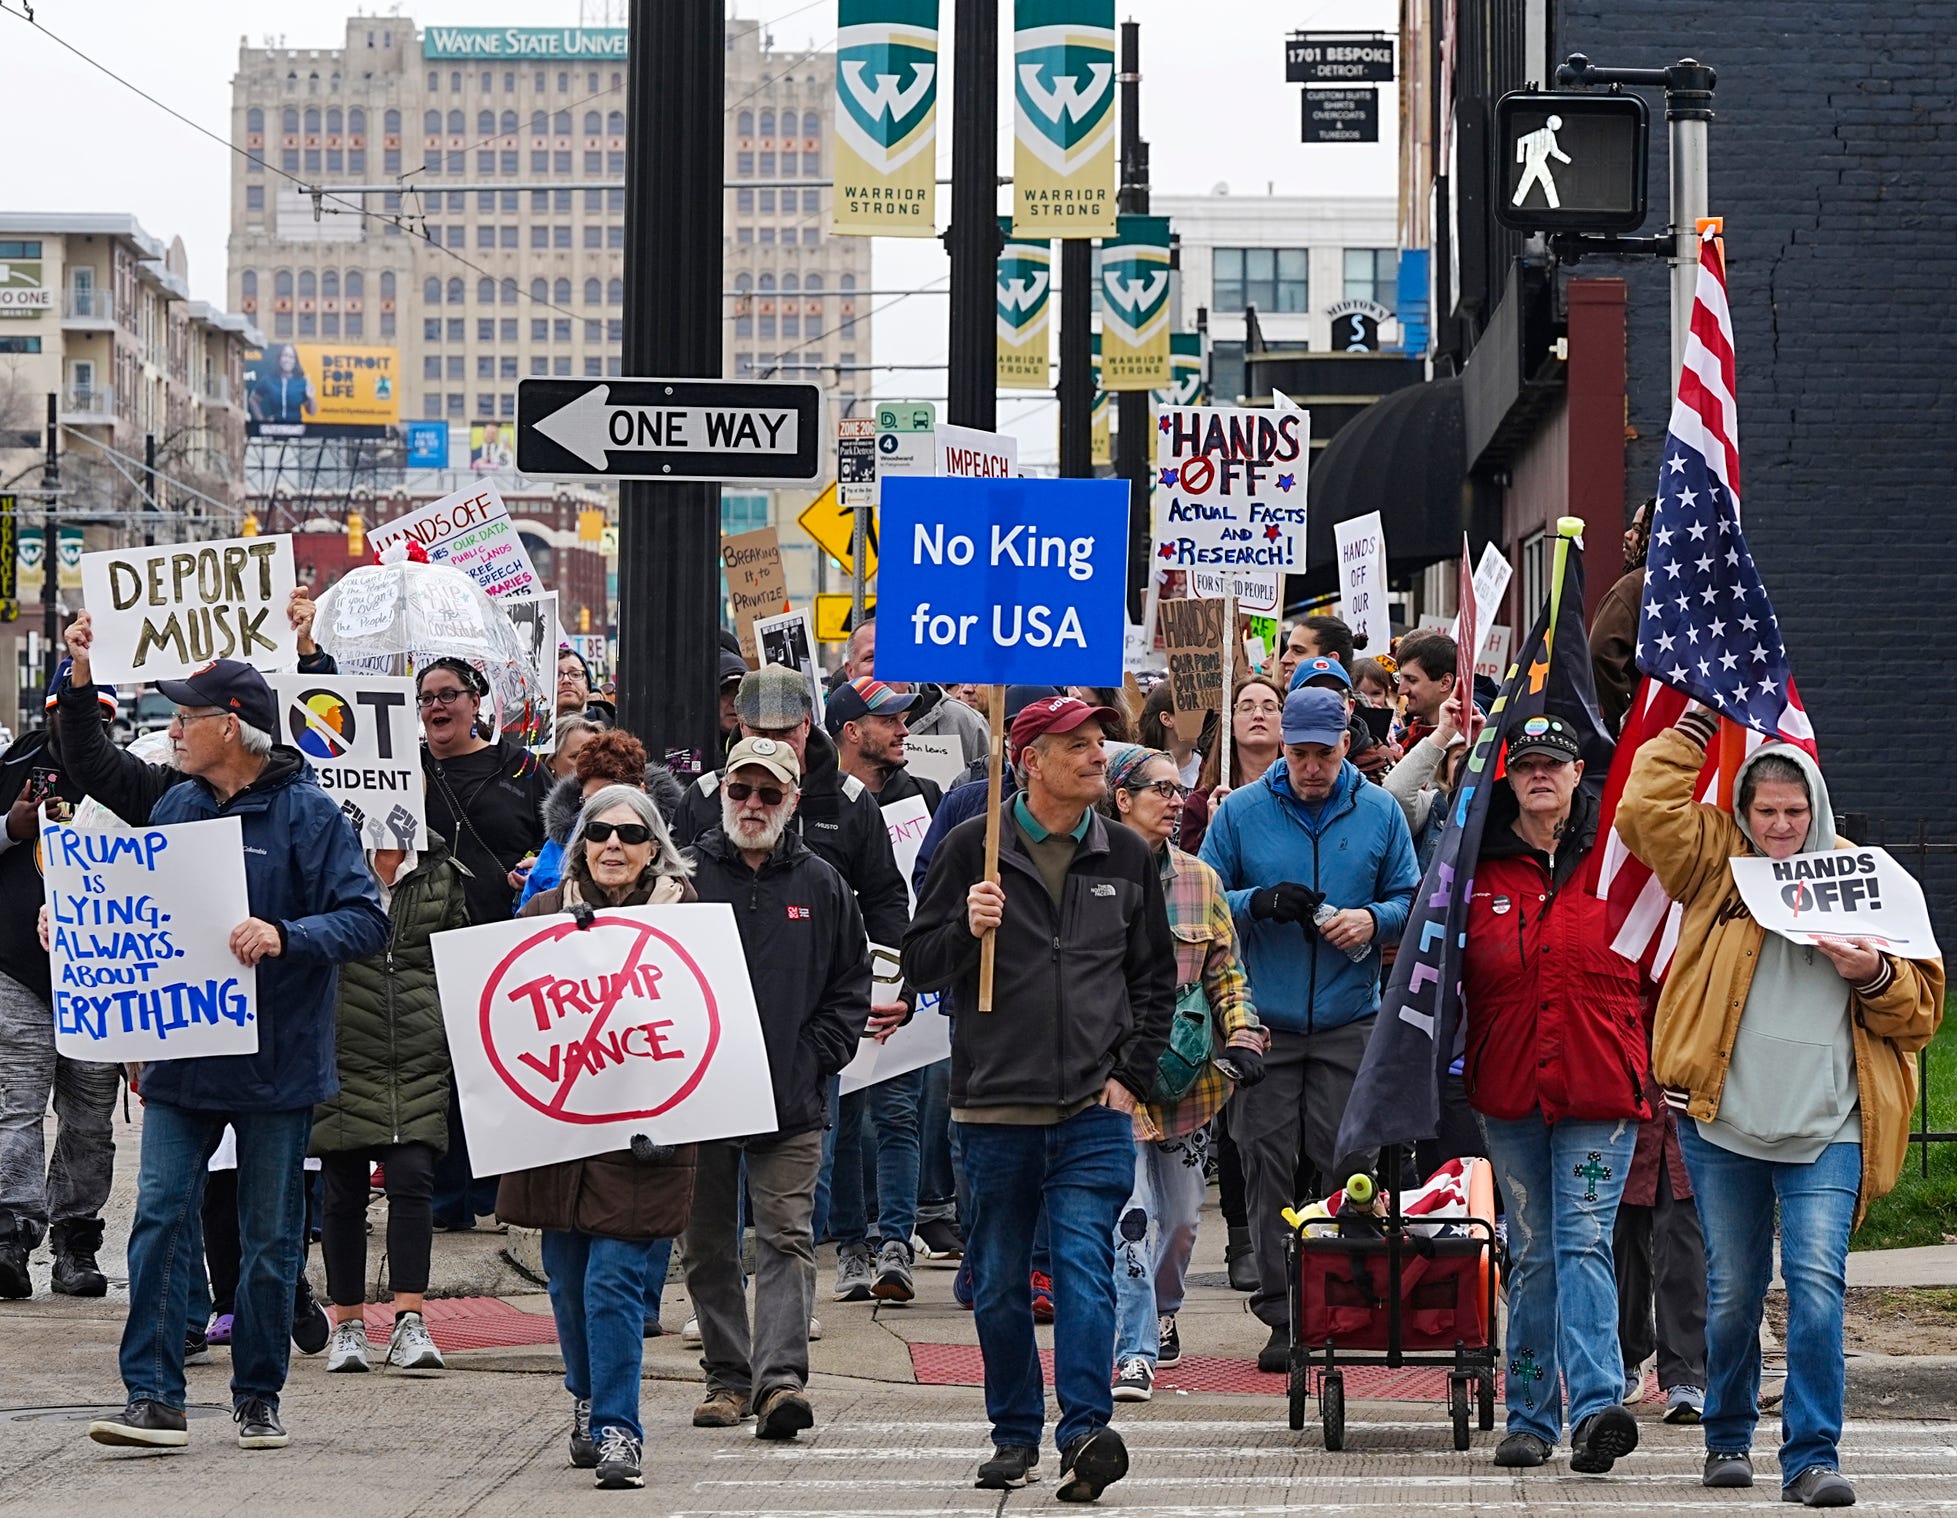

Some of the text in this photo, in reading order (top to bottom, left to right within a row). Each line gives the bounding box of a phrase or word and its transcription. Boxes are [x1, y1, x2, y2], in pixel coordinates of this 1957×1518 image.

[432, 29, 499, 53] WAYNE
[505, 29, 560, 53] STATE
[1288, 47, 1391, 63] 1701 BESPOKE
[1317, 64, 1364, 76] DETROIT
[845, 186, 926, 200] WARRIOR
[1024, 188, 1106, 201] WARRIOR
[850, 201, 920, 215] STRONG
[1030, 203, 1100, 216] STRONG
[17, 291, 49, 304] ONE
[1327, 300, 1386, 318] MIDTOWN
[322, 355, 391, 370] DETROIT
[998, 356, 1043, 364] ARRIOR
[1000, 366, 1039, 374] TRONG
[1109, 355, 1164, 364] WARRIOR
[1113, 366, 1160, 374] STRONG
[322, 370, 354, 383] FOR
[322, 385, 354, 398] LIFE
[609, 410, 788, 449] ONE WAY
[840, 421, 875, 436] ZONE 206
[1172, 412, 1300, 462] HANDS
[883, 438, 893, 450] 4
[946, 446, 1008, 478] IMPEACH
[1180, 456, 1274, 496] OFF
[452, 493, 492, 528] OFF
[453, 534, 479, 551] OUR
[480, 522, 509, 541] DATA
[1220, 527, 1253, 541] AND
[451, 543, 512, 565] PUBLIC LANDS
[913, 523, 1095, 580] No King
[1344, 536, 1376, 563] HANDS
[108, 541, 277, 610] DEPORT
[478, 559, 523, 587] SPEECH
[1351, 565, 1366, 588] OFF
[732, 586, 783, 612] PRIVATIZE
[1197, 574, 1275, 601] FOR STID PEOPLE
[1352, 592, 1369, 614] OUR
[132, 605, 278, 668] MUSK
[911, 602, 1087, 648] for USA
[588, 638, 602, 658] BE
[904, 743, 948, 755] John Lewis
[314, 767, 412, 791] SIDENT
[815, 821, 839, 830] MUSTO
[43, 825, 168, 871] TRUMP
[242, 845, 267, 855] Columbia
[1771, 853, 1876, 881] HANDS
[82, 875, 105, 893] IS
[1780, 877, 1882, 918] OFF!
[53, 890, 171, 929] LYING.
[54, 926, 184, 962] ALWAYS.
[62, 962, 159, 988] ABOUT
[54, 978, 255, 1040] ERYTHING.
[507, 964, 664, 1031] TRUMP
[517, 1019, 685, 1083] VANCE
